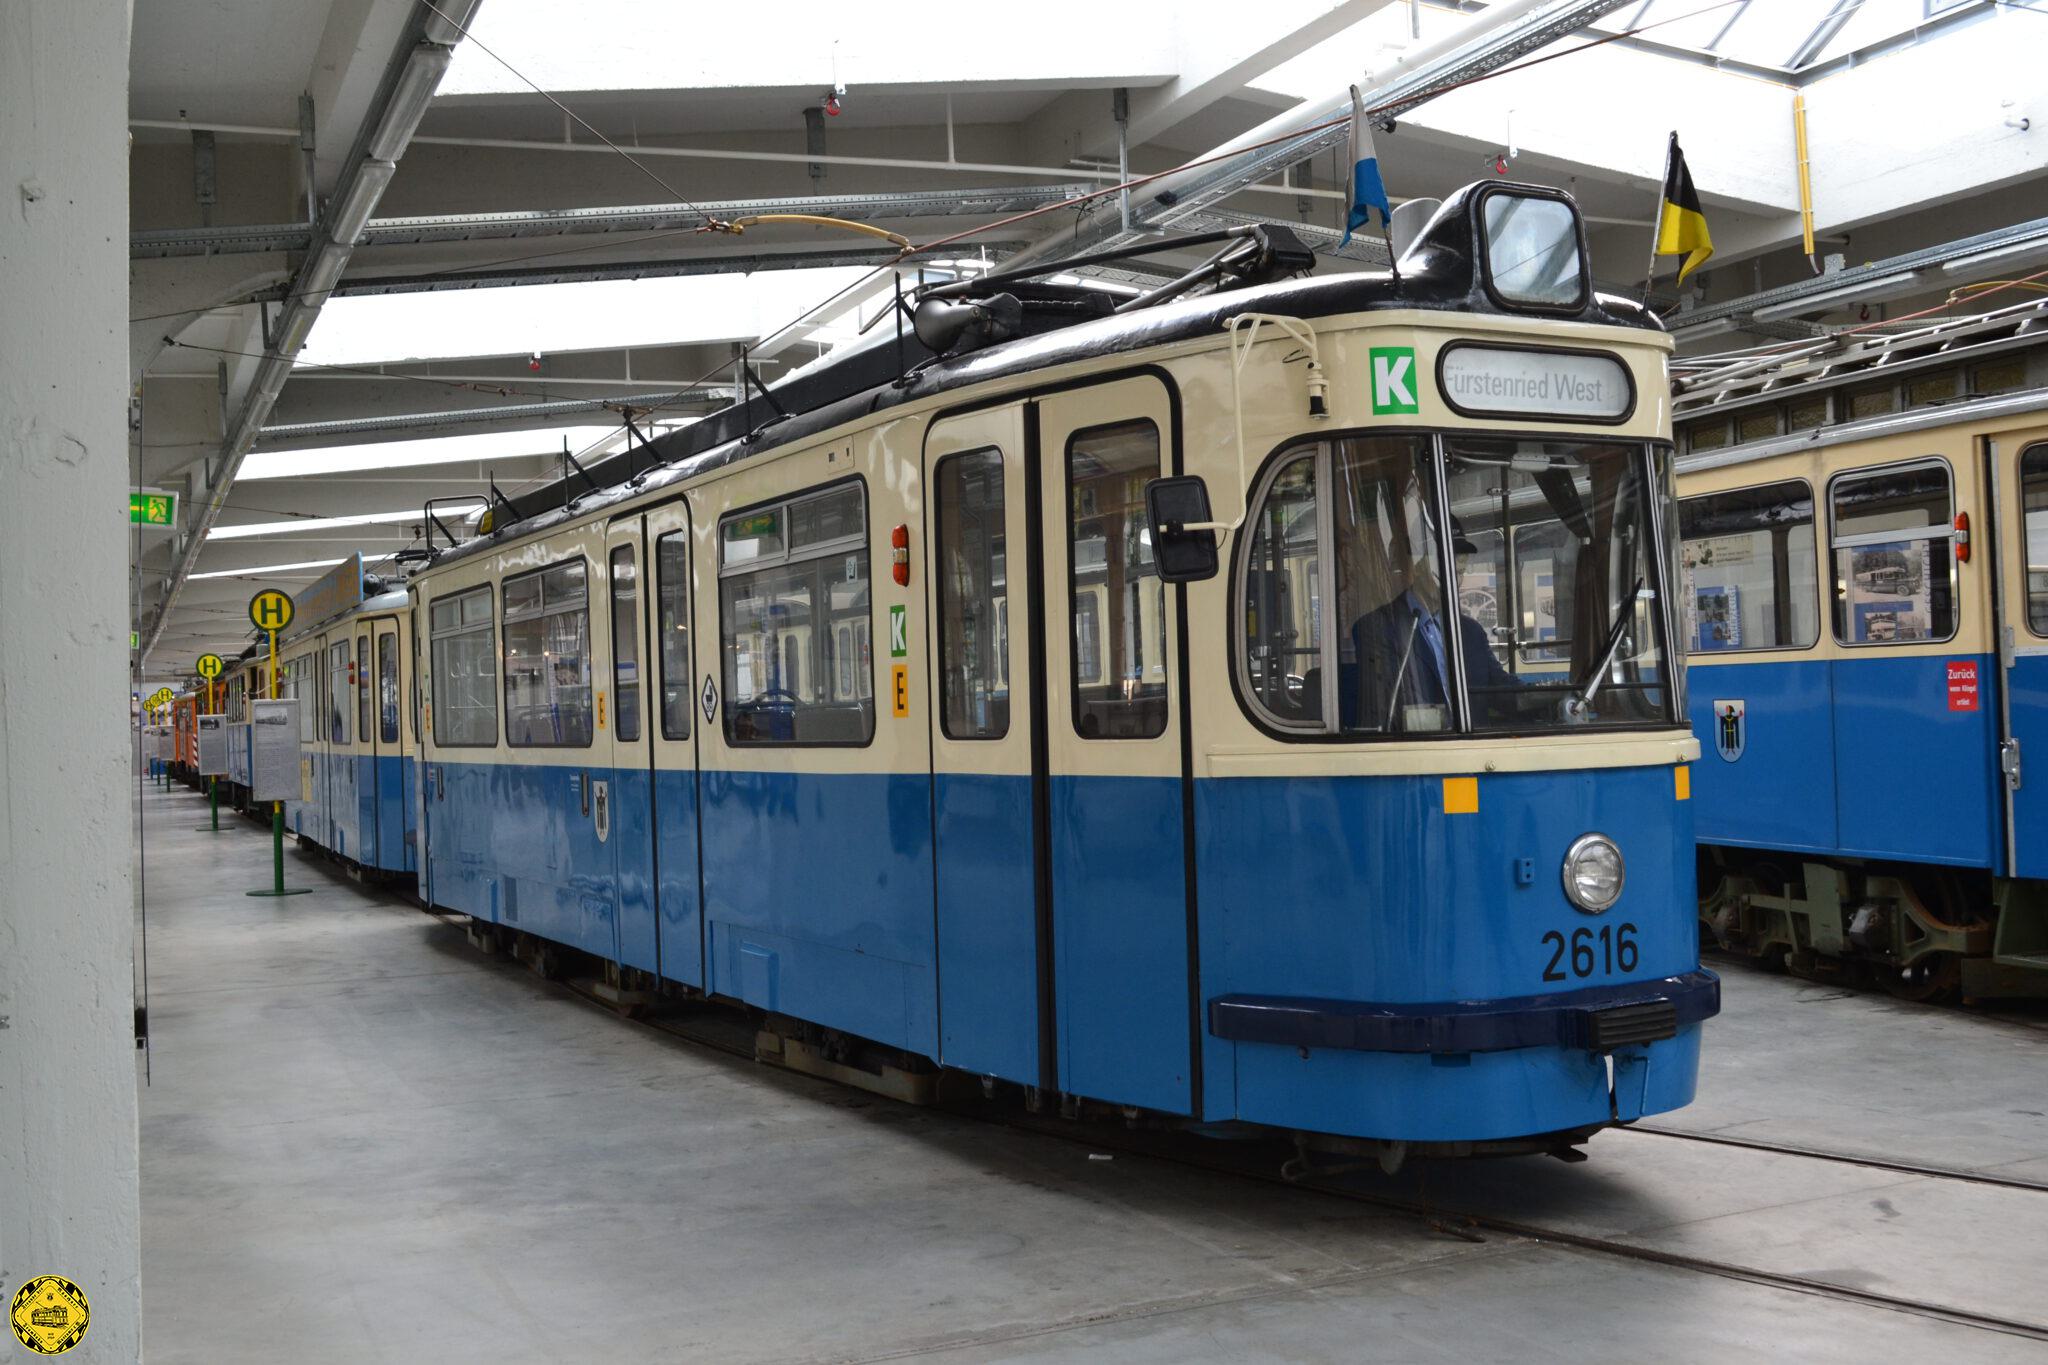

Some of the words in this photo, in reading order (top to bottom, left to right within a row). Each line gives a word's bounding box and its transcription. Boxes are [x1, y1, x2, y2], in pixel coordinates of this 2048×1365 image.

[1373, 356, 1416, 406] K
[1553, 374, 1603, 402] West
[260, 597, 283, 625] H
[892, 613, 905, 651] K
[203, 658, 217, 674] H
[1948, 669, 1975, 679] Zurück
[897, 673, 904, 710] E
[1541, 923, 1639, 982] 2616
